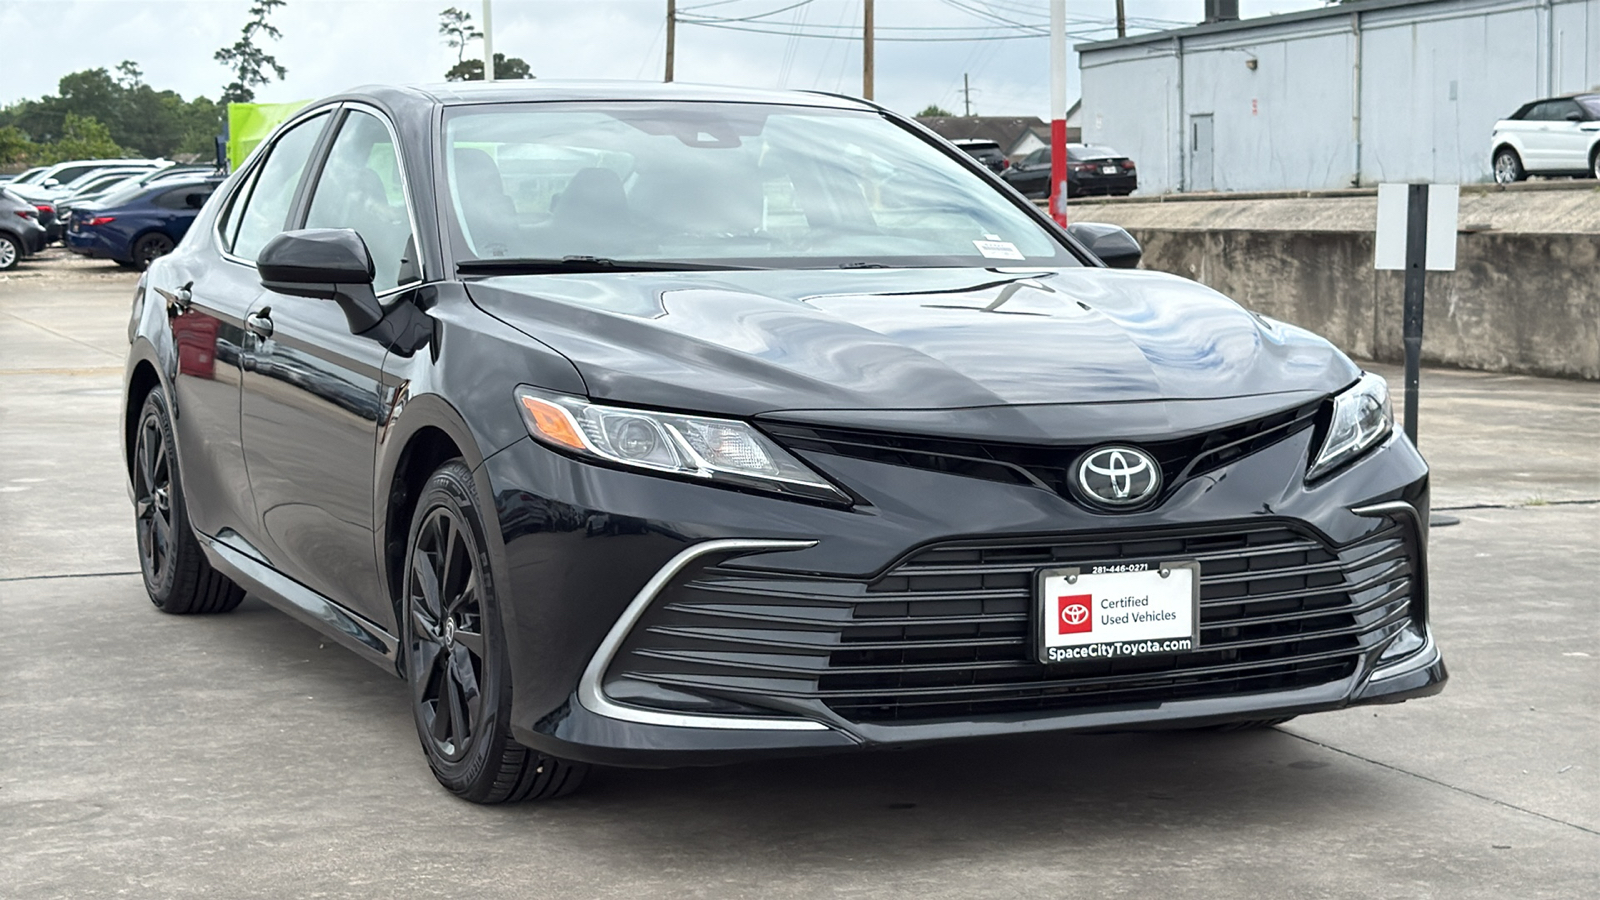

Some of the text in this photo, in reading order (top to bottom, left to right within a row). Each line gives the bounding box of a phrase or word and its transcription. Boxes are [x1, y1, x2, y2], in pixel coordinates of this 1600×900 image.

[1092, 563, 1148, 574] 281-446-0271
[1100, 595, 1149, 609] Certified
[1101, 610, 1177, 625] Used Vehicles
[1048, 639, 1191, 661] SpaceCityToyota.com
